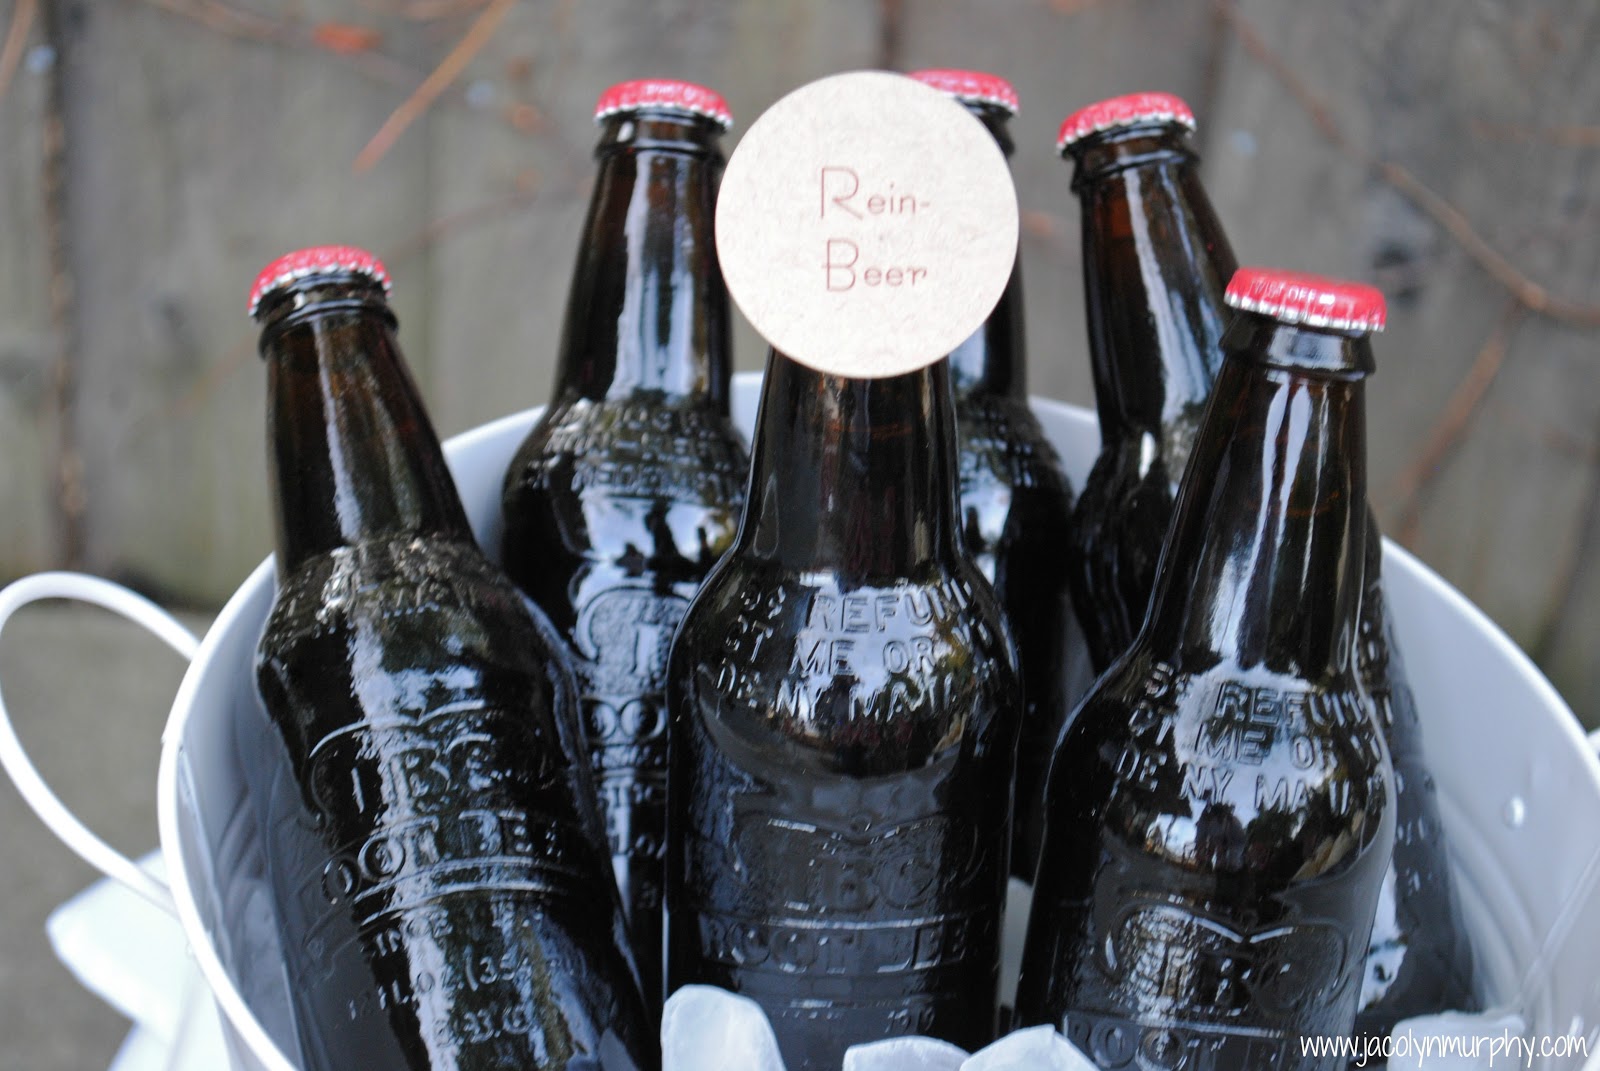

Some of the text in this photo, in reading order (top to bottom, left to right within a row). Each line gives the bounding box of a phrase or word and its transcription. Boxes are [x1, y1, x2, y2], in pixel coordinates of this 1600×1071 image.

[820, 166, 930, 220] Rein-
[820, 238, 927, 292] Beer
[789, 638, 856, 676] ME
[882, 635, 938, 675] OR
[1193, 722, 1268, 766] ME
[1179, 765, 1234, 806] NY
